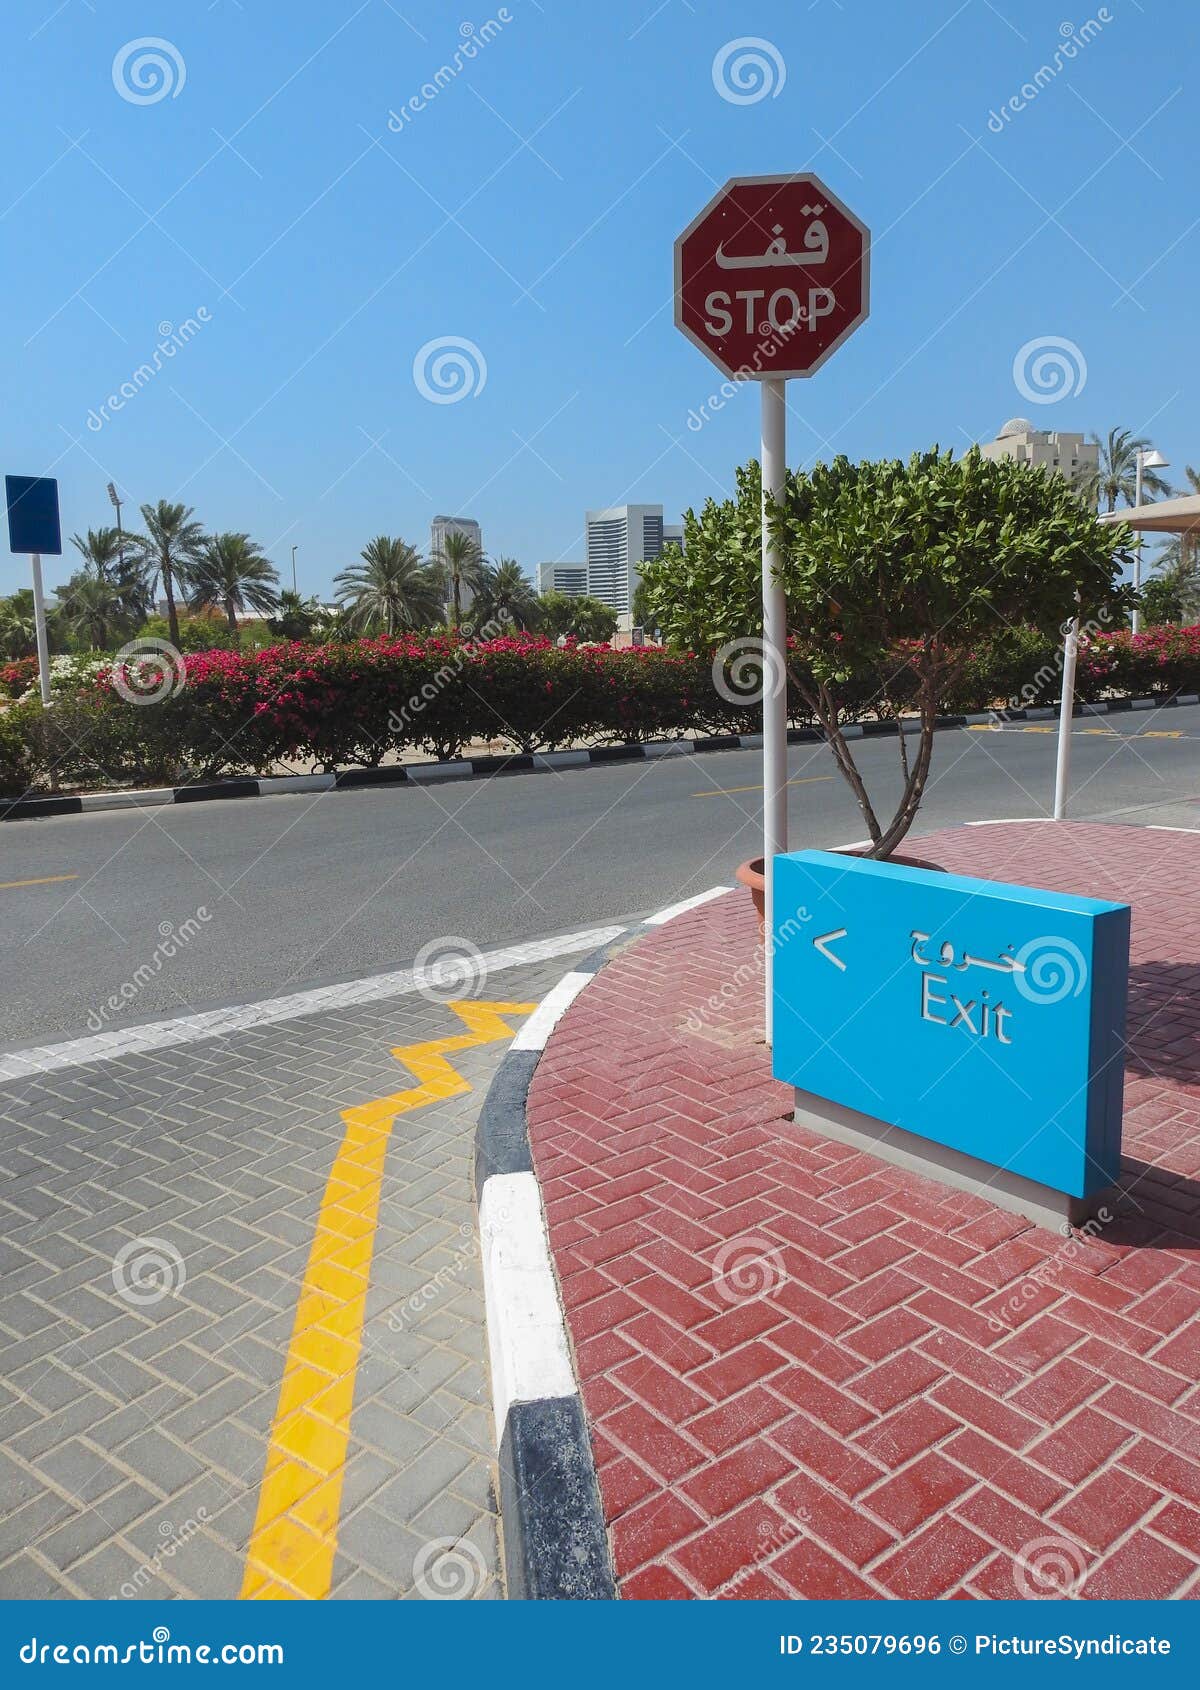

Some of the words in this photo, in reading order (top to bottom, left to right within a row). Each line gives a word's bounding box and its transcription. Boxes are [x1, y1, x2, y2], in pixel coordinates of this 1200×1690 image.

[714, 203, 830, 270] قف
[703, 287, 836, 337] STOP
[909, 929, 1028, 974] خروج
[920, 970, 1014, 1045] Exit
